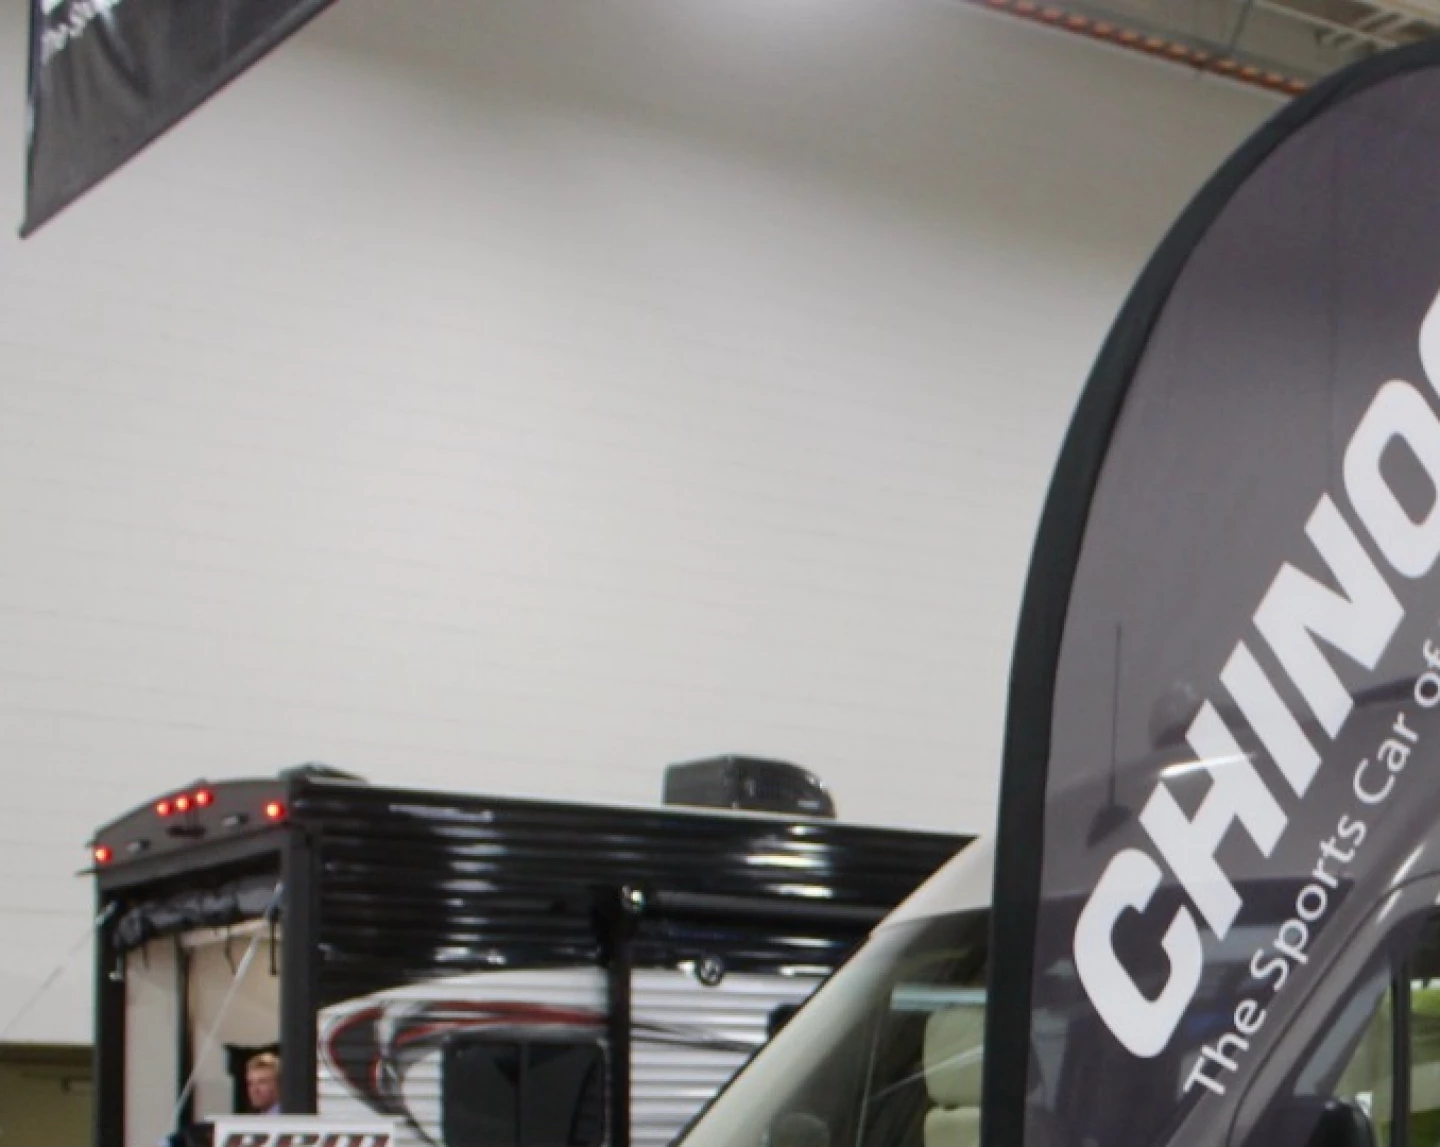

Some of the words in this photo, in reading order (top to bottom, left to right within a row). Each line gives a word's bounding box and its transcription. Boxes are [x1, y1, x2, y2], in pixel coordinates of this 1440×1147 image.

[1183, 1000, 1267, 1095] The
[1250, 814, 1366, 991] Sports
[1353, 711, 1419, 803] Car
